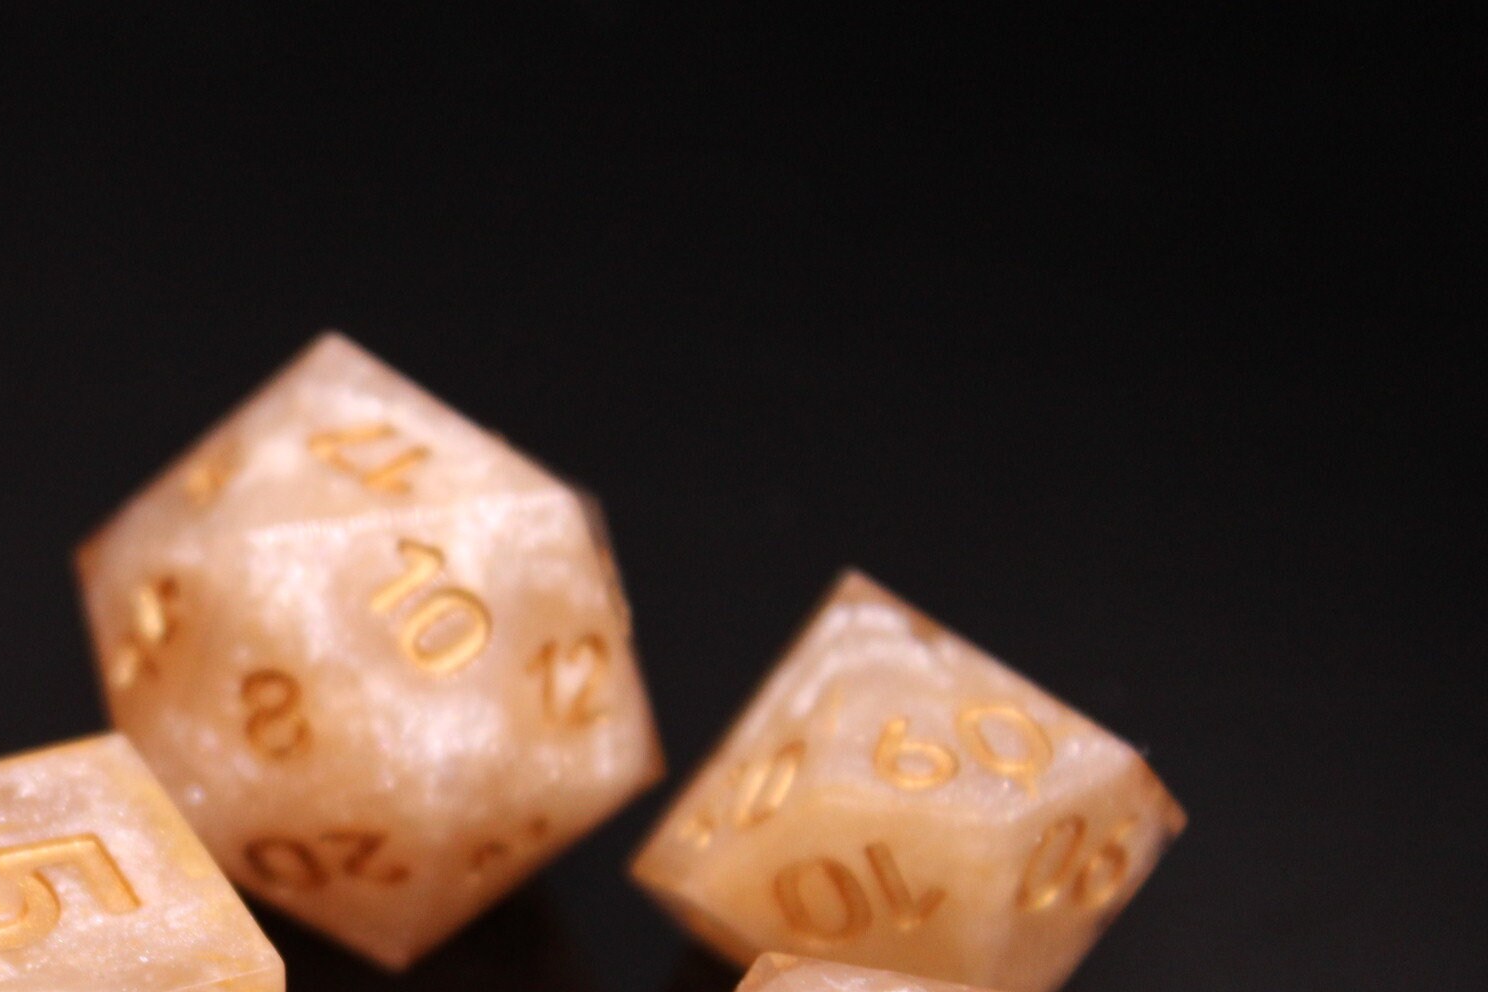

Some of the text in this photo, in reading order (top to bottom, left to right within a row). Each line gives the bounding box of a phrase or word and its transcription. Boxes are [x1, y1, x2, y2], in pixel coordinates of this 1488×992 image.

[372, 537, 492, 674] 10
[239, 667, 309, 761] 8
[525, 633, 609, 730] 12
[242, 828, 410, 888] 20
[772, 840, 948, 942] 10
